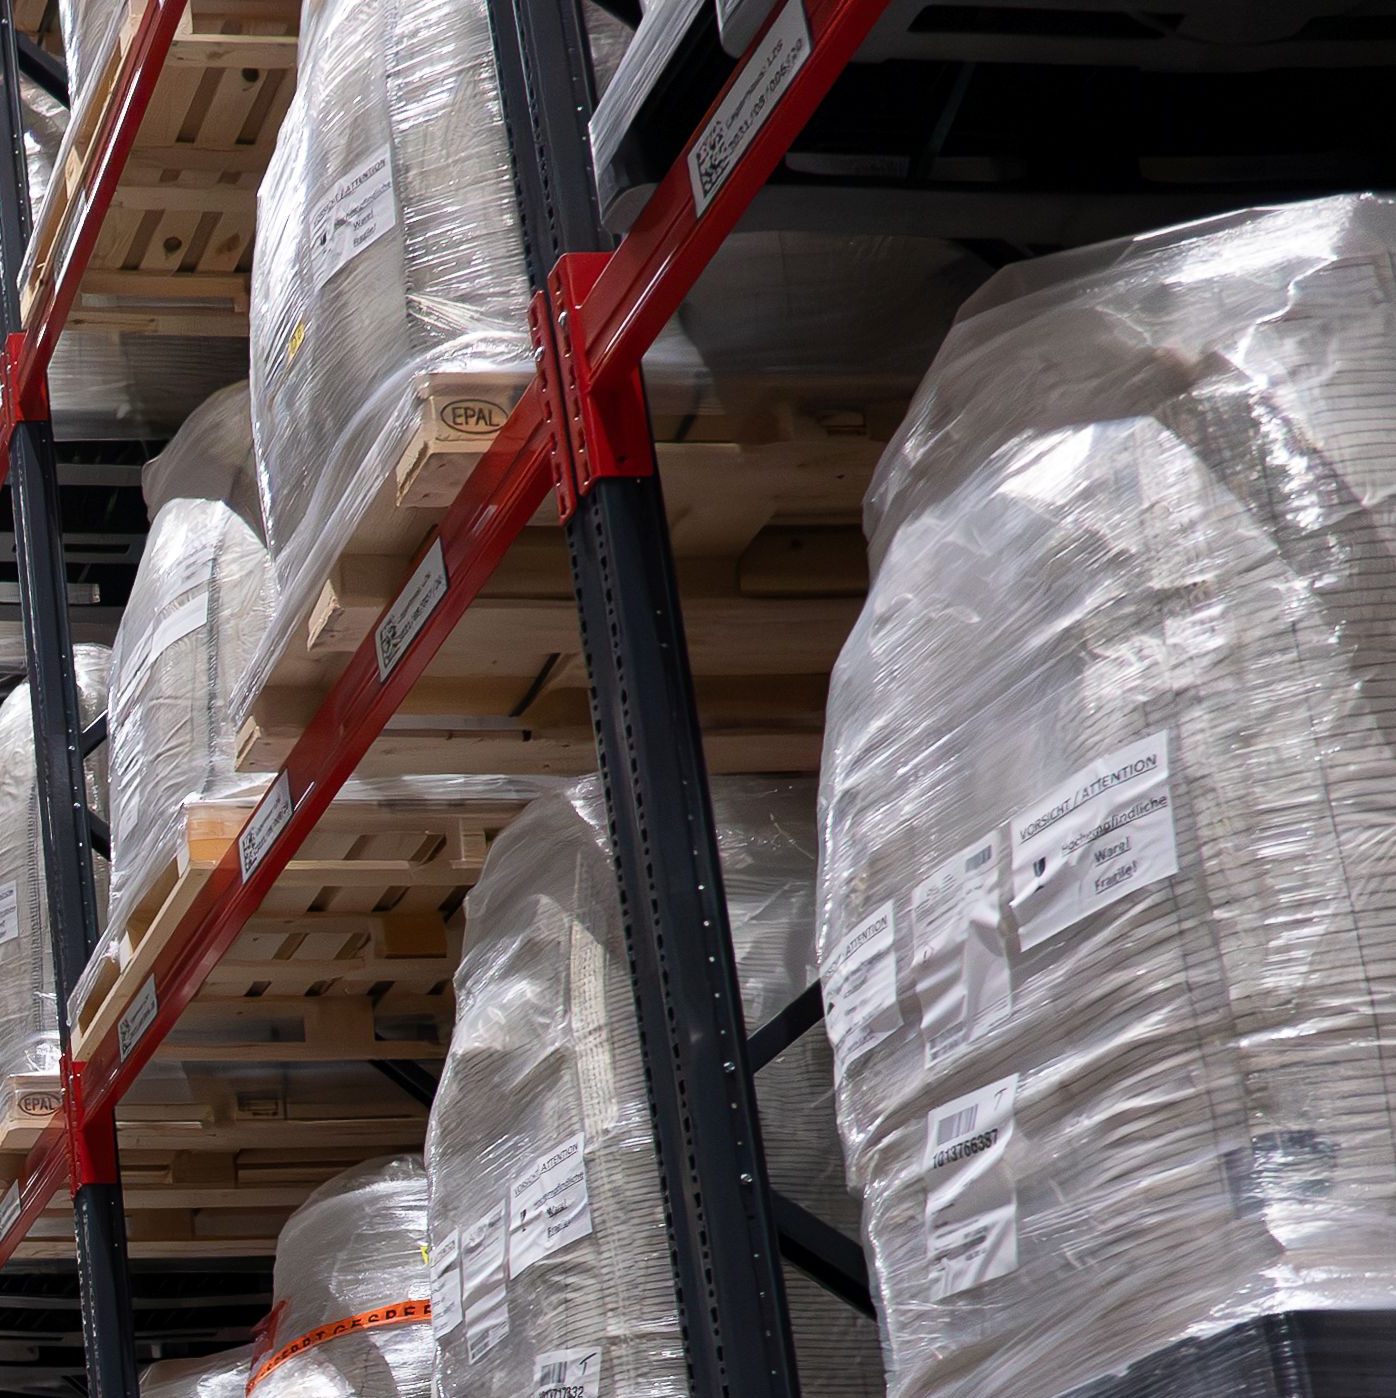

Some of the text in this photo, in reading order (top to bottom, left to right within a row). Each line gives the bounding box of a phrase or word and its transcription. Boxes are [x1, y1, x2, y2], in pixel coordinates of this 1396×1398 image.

[452, 407, 500, 427] EPAL
[1019, 798, 1071, 841] VORSICHT
[1082, 754, 1158, 800] ATTENTION
[1094, 837, 1131, 863] Ware!
[845, 914, 888, 956] ATTENTION
[24, 1097, 55, 1111] EPAL
